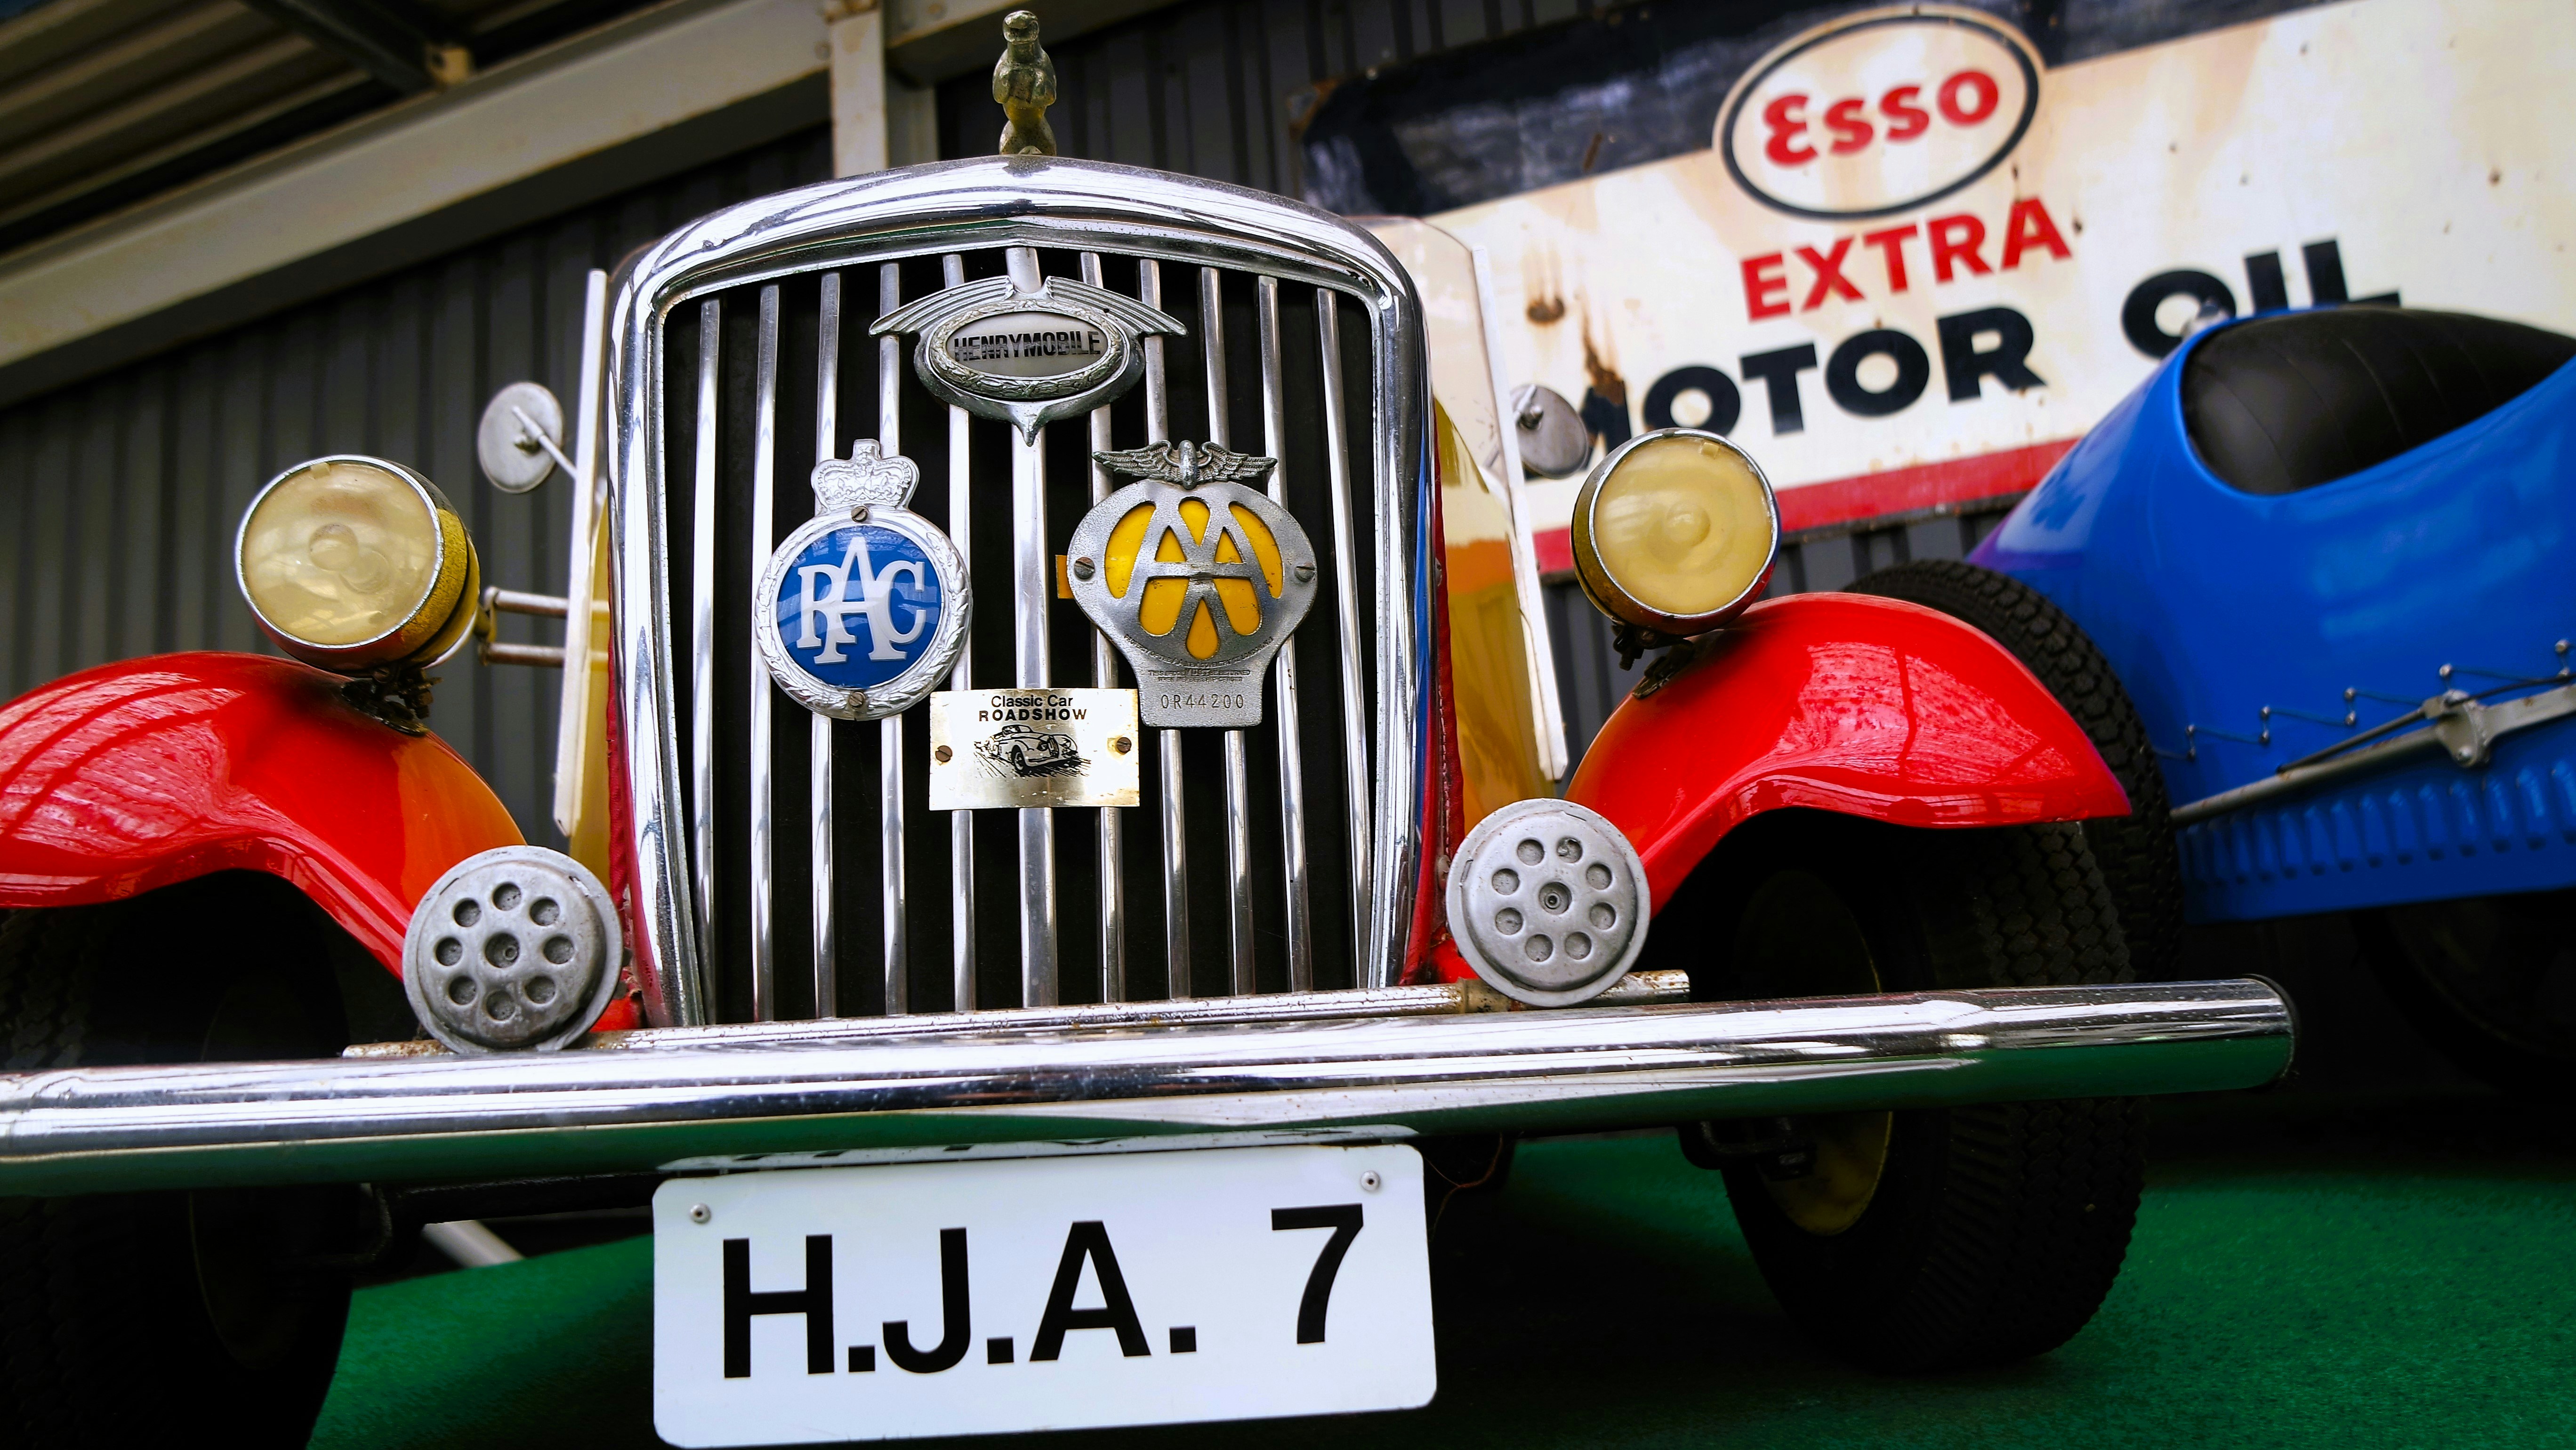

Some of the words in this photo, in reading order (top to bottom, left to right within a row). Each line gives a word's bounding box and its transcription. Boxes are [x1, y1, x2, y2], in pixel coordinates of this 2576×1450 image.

[1740, 195, 2071, 322] EXTRA
[2121, 239, 2400, 360] OIL
[954, 331, 1101, 361] HENRYMOBILE
[797, 537, 926, 664] RAC
[979, 708, 1087, 722] ROADSHOW
[991, 694, 1042, 708] Classic
[1047, 694, 1073, 707] Car
[723, 1219, 1197, 1378] H.J.A.
[1271, 1203, 1364, 1345] 7
